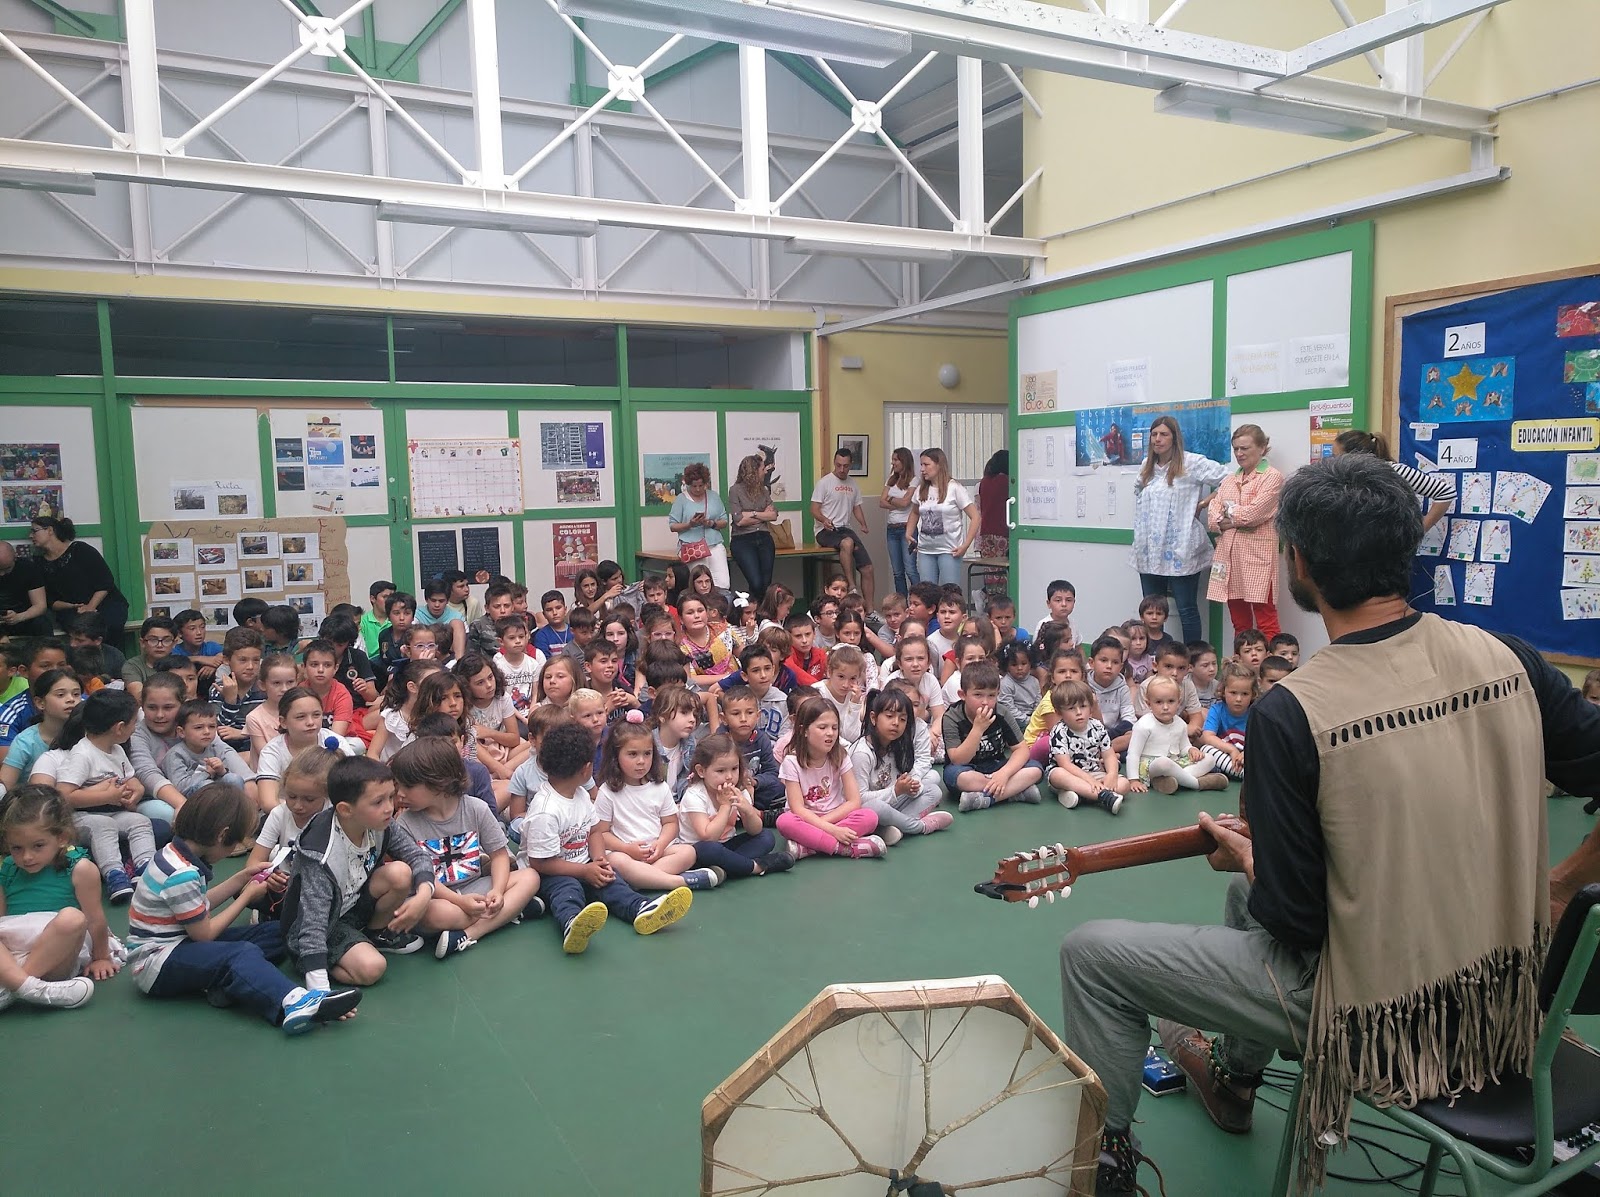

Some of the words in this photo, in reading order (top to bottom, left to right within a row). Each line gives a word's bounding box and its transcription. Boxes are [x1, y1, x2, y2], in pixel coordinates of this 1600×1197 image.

[1448, 332, 1460, 352] 2
[1460, 341, 1482, 351] AÑOS
[1518, 424, 1559, 443] EDUCACIÓN
[1560, 426, 1593, 442] INFANTIL
[1441, 445, 1453, 463] 4
[1453, 455, 1473, 463] AÑOS
